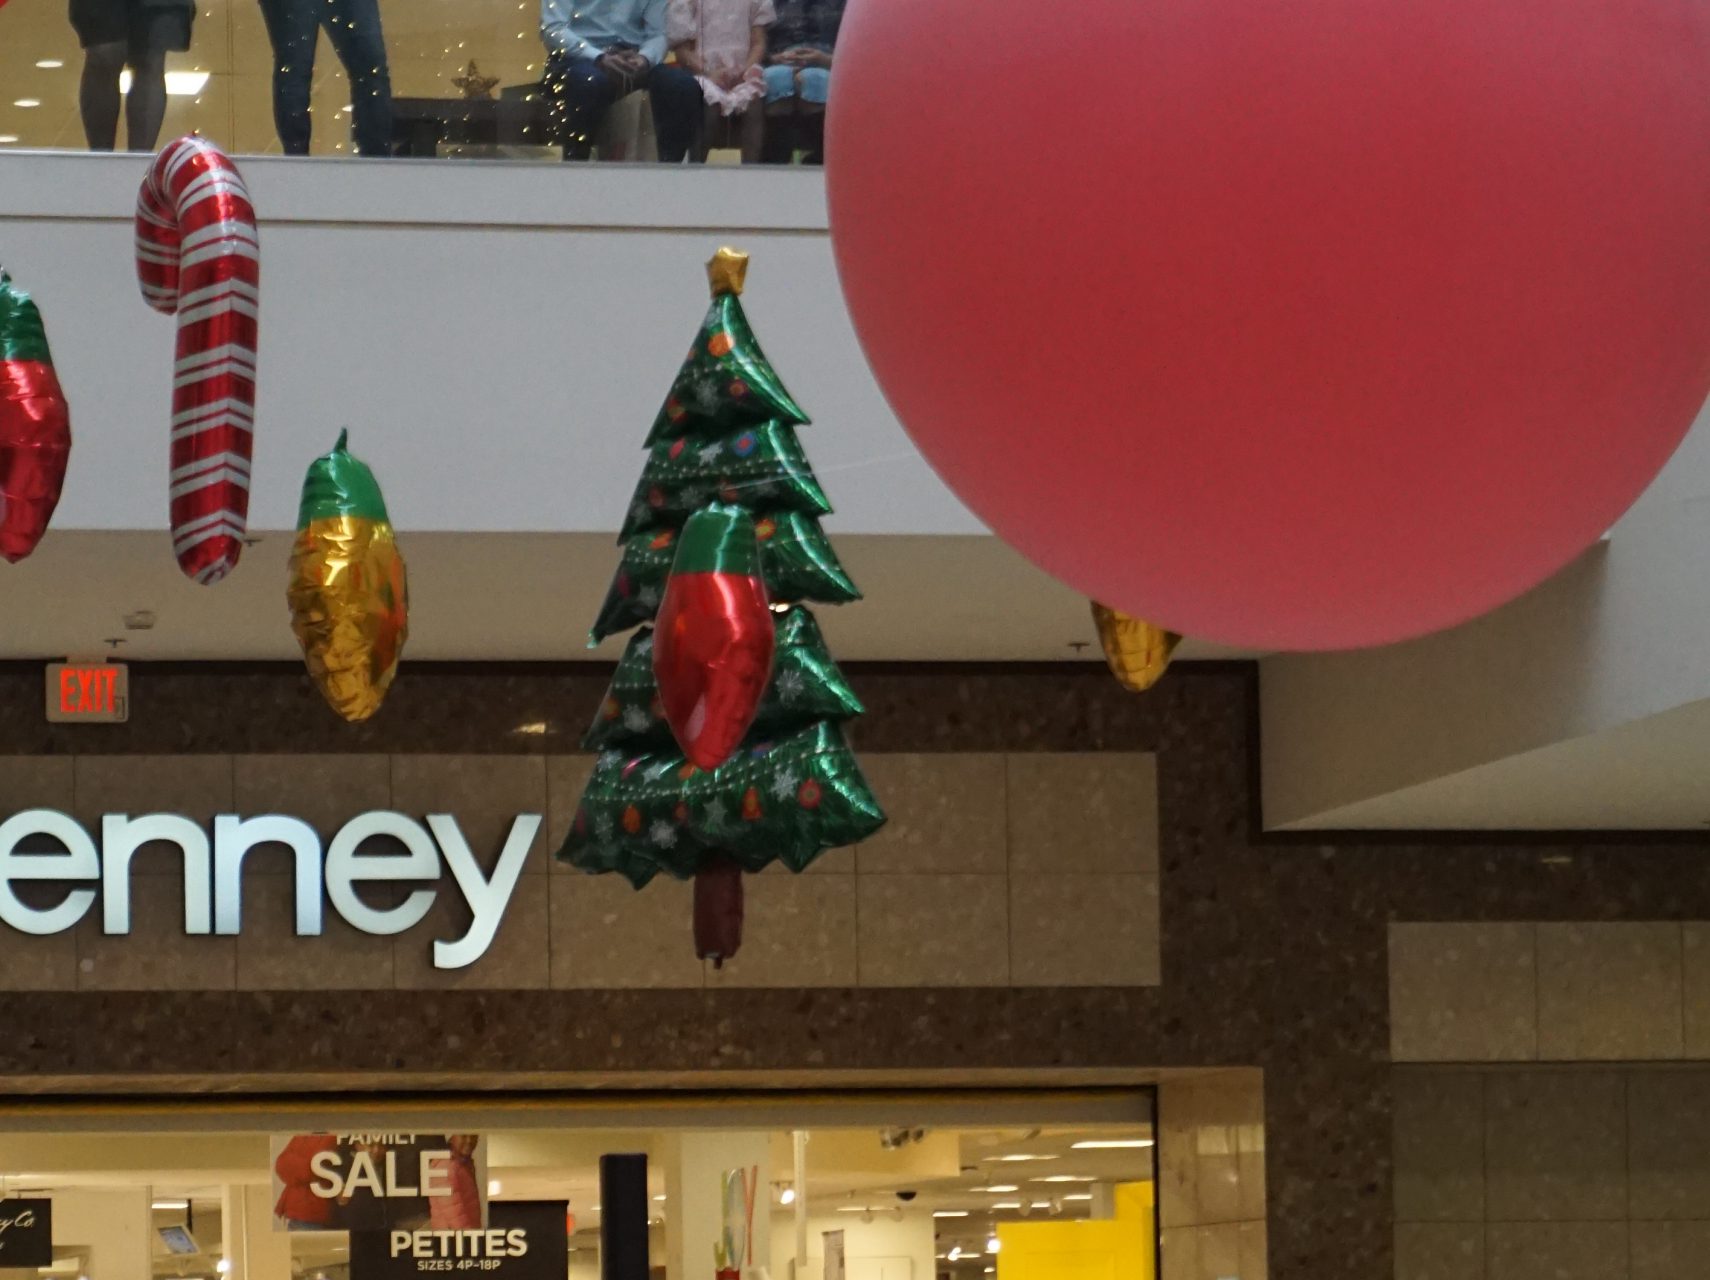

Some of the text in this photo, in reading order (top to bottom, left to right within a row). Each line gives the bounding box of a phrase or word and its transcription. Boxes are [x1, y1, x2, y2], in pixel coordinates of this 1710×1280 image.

[60, 668, 118, 713] EXIT
[0, 808, 543, 969] enney
[310, 1150, 452, 1198] SALE
[391, 1229, 528, 1258] PETITES
[417, 1260, 501, 1271] SIZES 4P-18P
